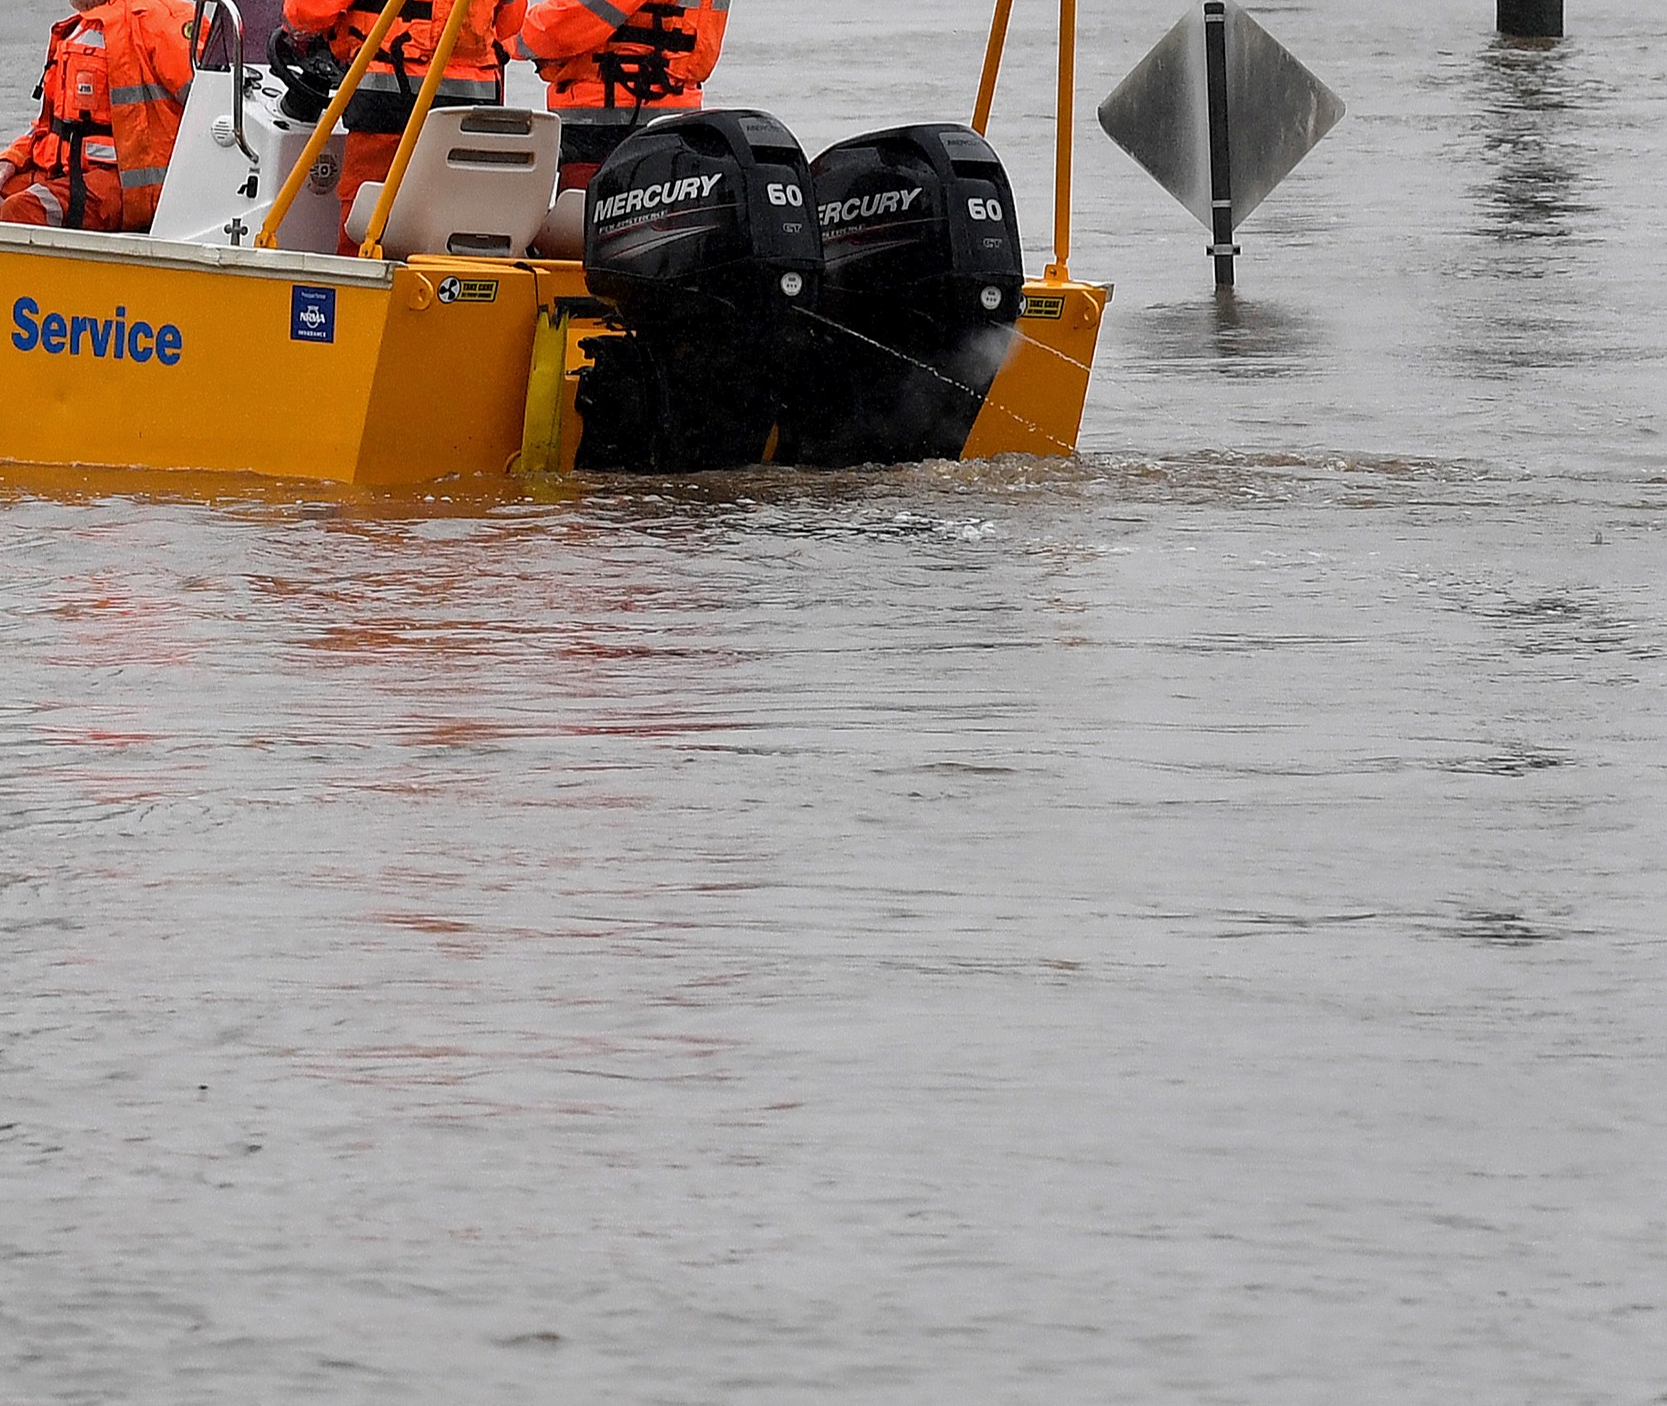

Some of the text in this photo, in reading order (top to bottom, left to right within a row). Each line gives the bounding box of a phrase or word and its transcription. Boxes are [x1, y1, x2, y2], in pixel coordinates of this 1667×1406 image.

[593, 172, 723, 223] MERCURY
[767, 183, 803, 207] 60
[817, 188, 923, 226] ERCURY
[968, 198, 1003, 222] 60
[11, 296, 183, 366] Service
[299, 312, 325, 324] NRMA
